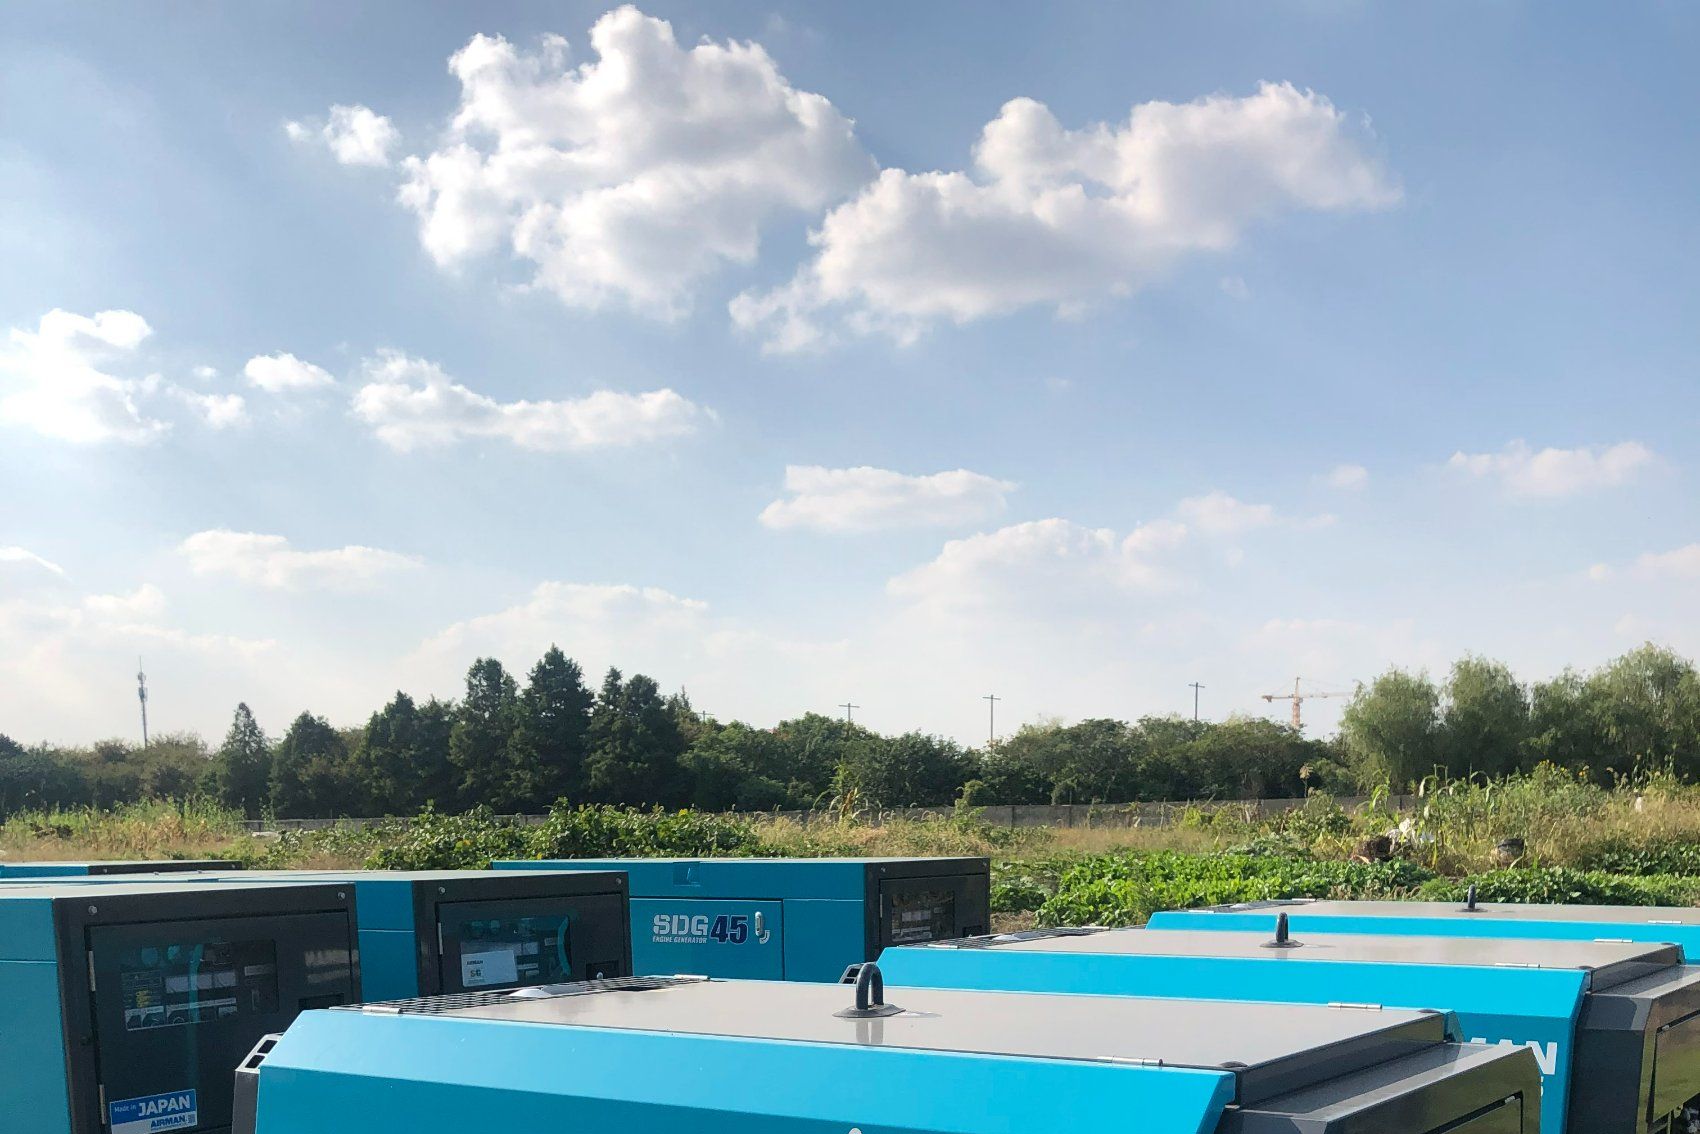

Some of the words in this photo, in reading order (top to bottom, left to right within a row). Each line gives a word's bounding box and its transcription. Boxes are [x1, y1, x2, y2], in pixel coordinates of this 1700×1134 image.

[653, 914, 709, 936] SDG
[710, 914, 749, 945] 45
[674, 936, 707, 945] GENERATOR
[138, 1095, 190, 1117] JAPAN
[150, 1115, 186, 1128] AIRMAN
